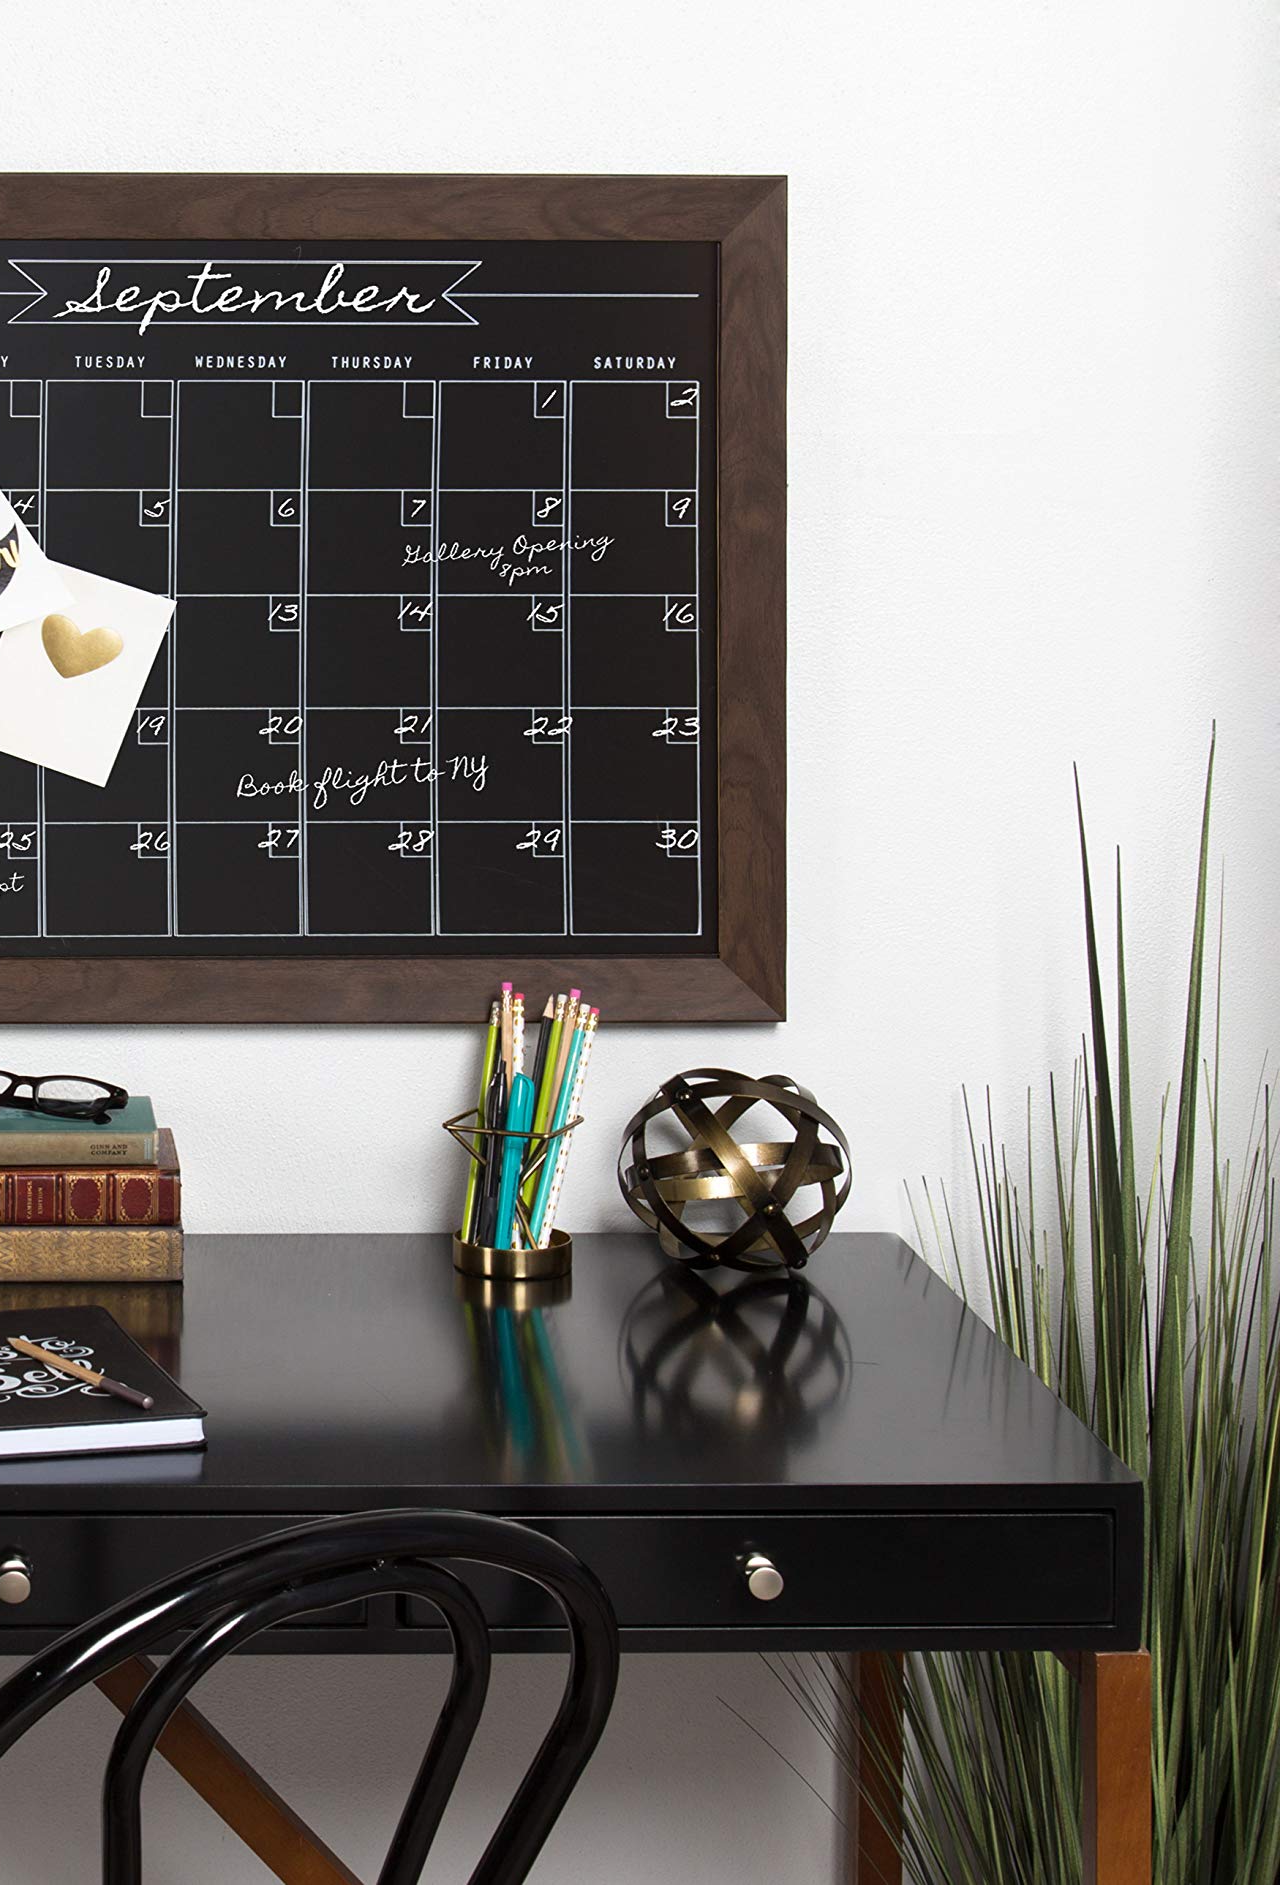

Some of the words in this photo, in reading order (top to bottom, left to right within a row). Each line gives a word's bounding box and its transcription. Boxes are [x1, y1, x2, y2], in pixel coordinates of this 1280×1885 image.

[53, 262, 435, 336] September
[75, 355, 146, 369] TUESDAY
[195, 355, 288, 369] WEDNESDAY
[331, 356, 413, 369] THURSDAY
[473, 356, 533, 369] FRIDAY
[593, 357, 677, 370] SATURDAY
[541, 389, 558, 409] 1
[669, 387, 699, 407] 2
[13, 494, 36, 515] 4
[143, 498, 171, 518] 5
[277, 498, 295, 518] 6
[410, 498, 427, 518] 7
[537, 497, 563, 519] 8
[672, 497, 692, 519] 9
[401, 543, 505, 570] Gallery
[512, 534, 615, 561] Opening
[498, 562, 553, 587] 8pm
[268, 603, 299, 622] 13
[397, 602, 434, 621] 14
[526, 602, 565, 623] 15
[662, 602, 695, 623] 16
[136, 715, 166, 736] 19
[258, 715, 303, 735] 20
[394, 714, 433, 735] 21
[523, 716, 573, 737] 22
[652, 717, 700, 737] 23
[236, 770, 309, 798] Book
[313, 757, 408, 810] flight
[414, 757, 446, 783] to
[129, 830, 171, 852] 26
[258, 829, 300, 849] 27
[387, 829, 435, 852] 28
[516, 828, 562, 852] 29
[655, 828, 699, 850] 30
